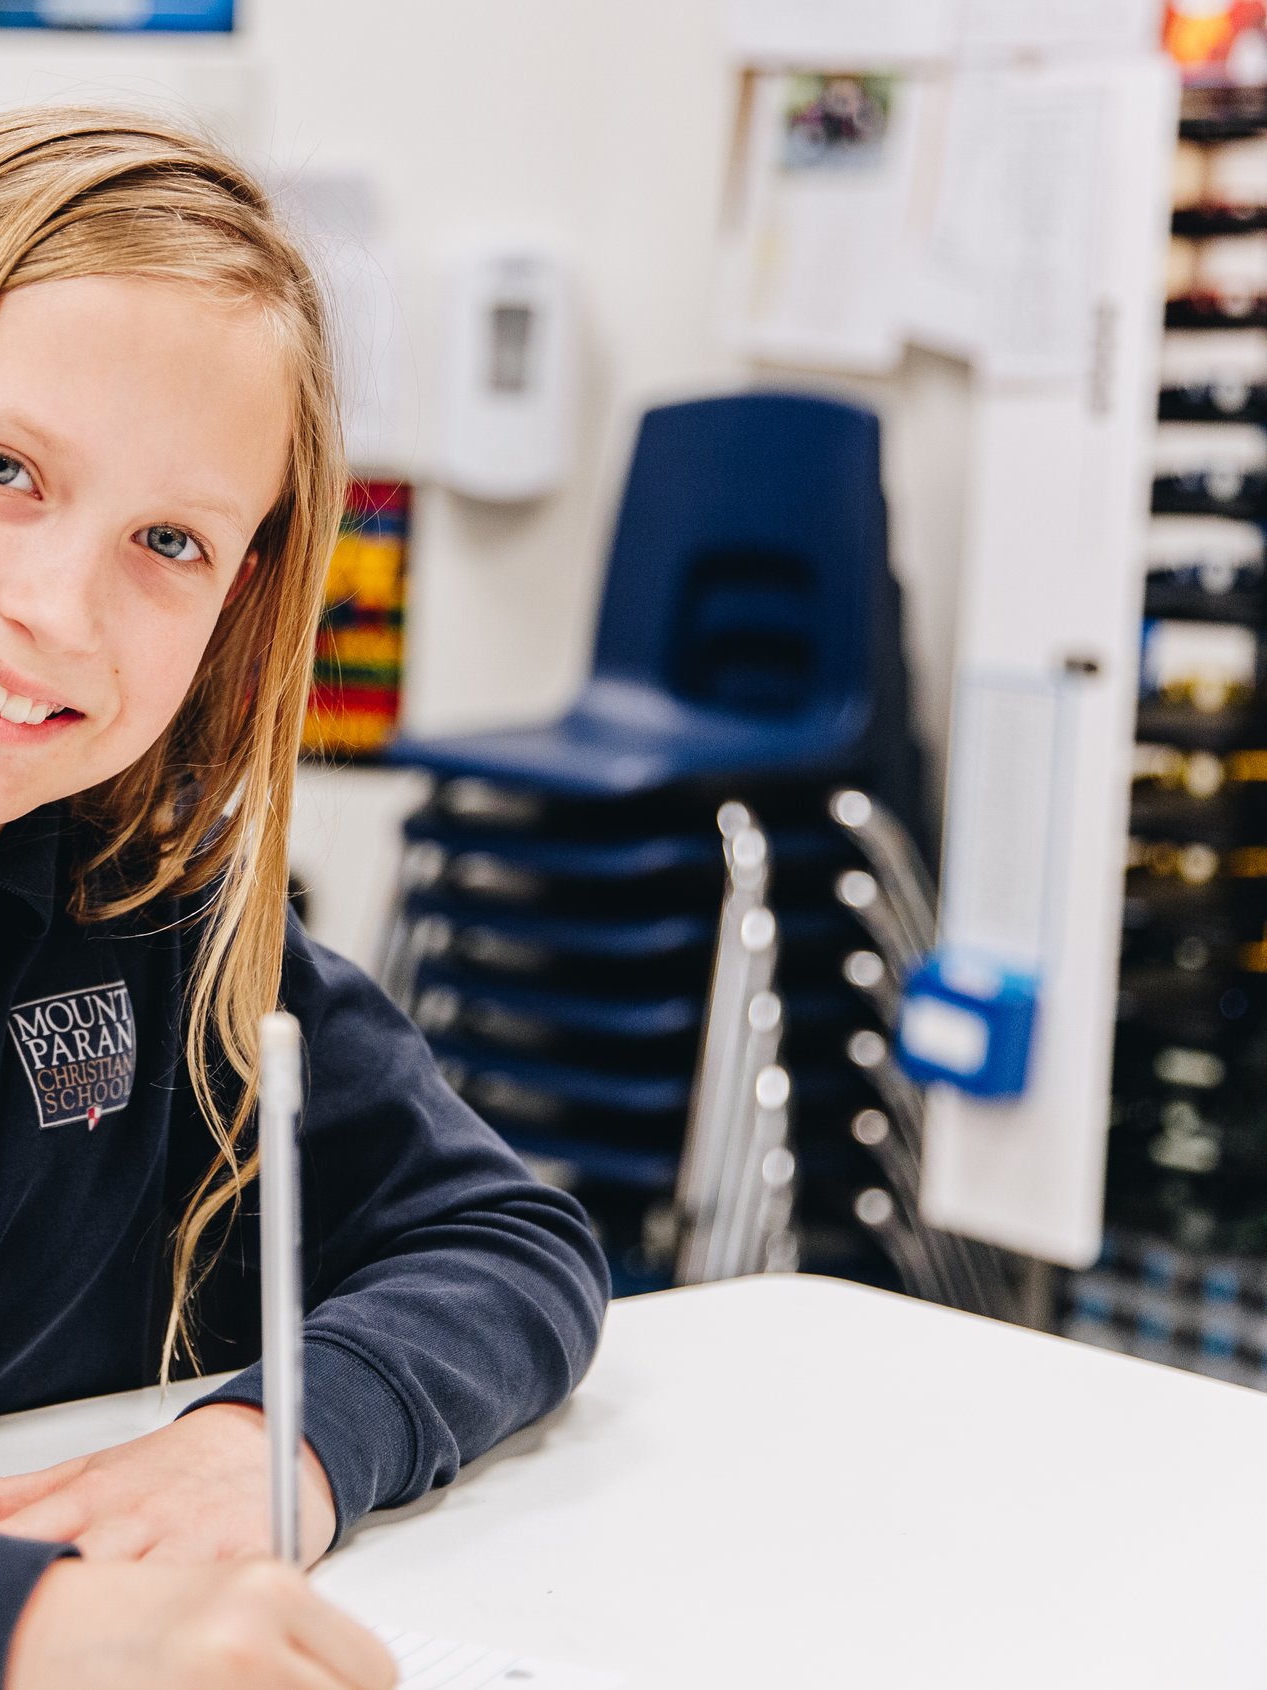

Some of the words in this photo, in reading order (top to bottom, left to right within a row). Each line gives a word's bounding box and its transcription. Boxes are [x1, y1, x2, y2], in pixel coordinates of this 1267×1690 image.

[12, 988, 128, 1041] MOUNT
[24, 1020, 133, 1070] PARAN
[37, 1052, 133, 1092] CHRISTIAN
